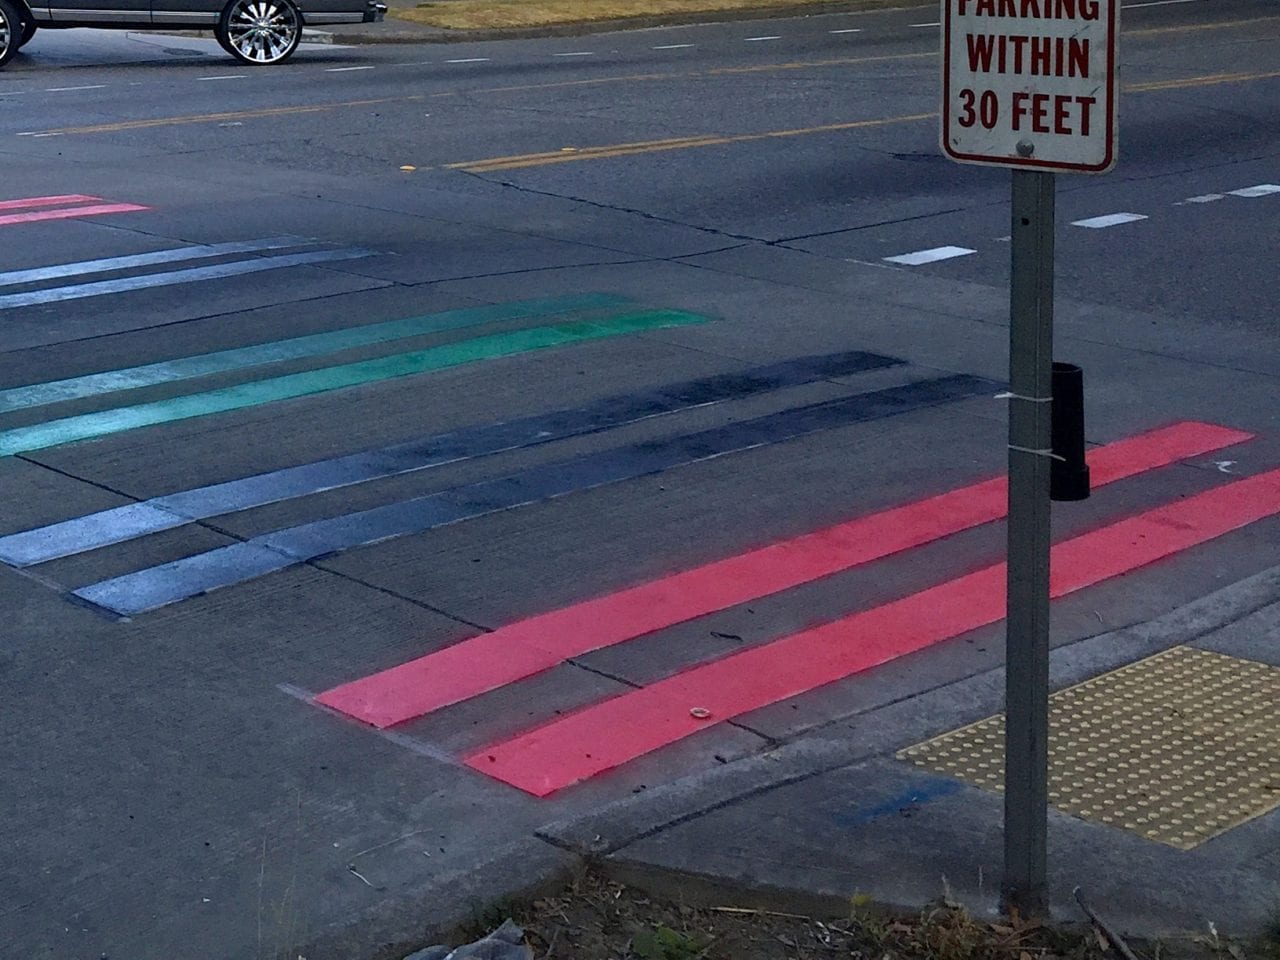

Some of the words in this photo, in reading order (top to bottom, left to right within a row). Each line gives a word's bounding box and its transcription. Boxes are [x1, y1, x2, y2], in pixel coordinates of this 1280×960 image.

[966, 33, 1090, 78] WITHIN
[958, 89, 999, 130] 30
[1011, 92, 1097, 136] FEET
